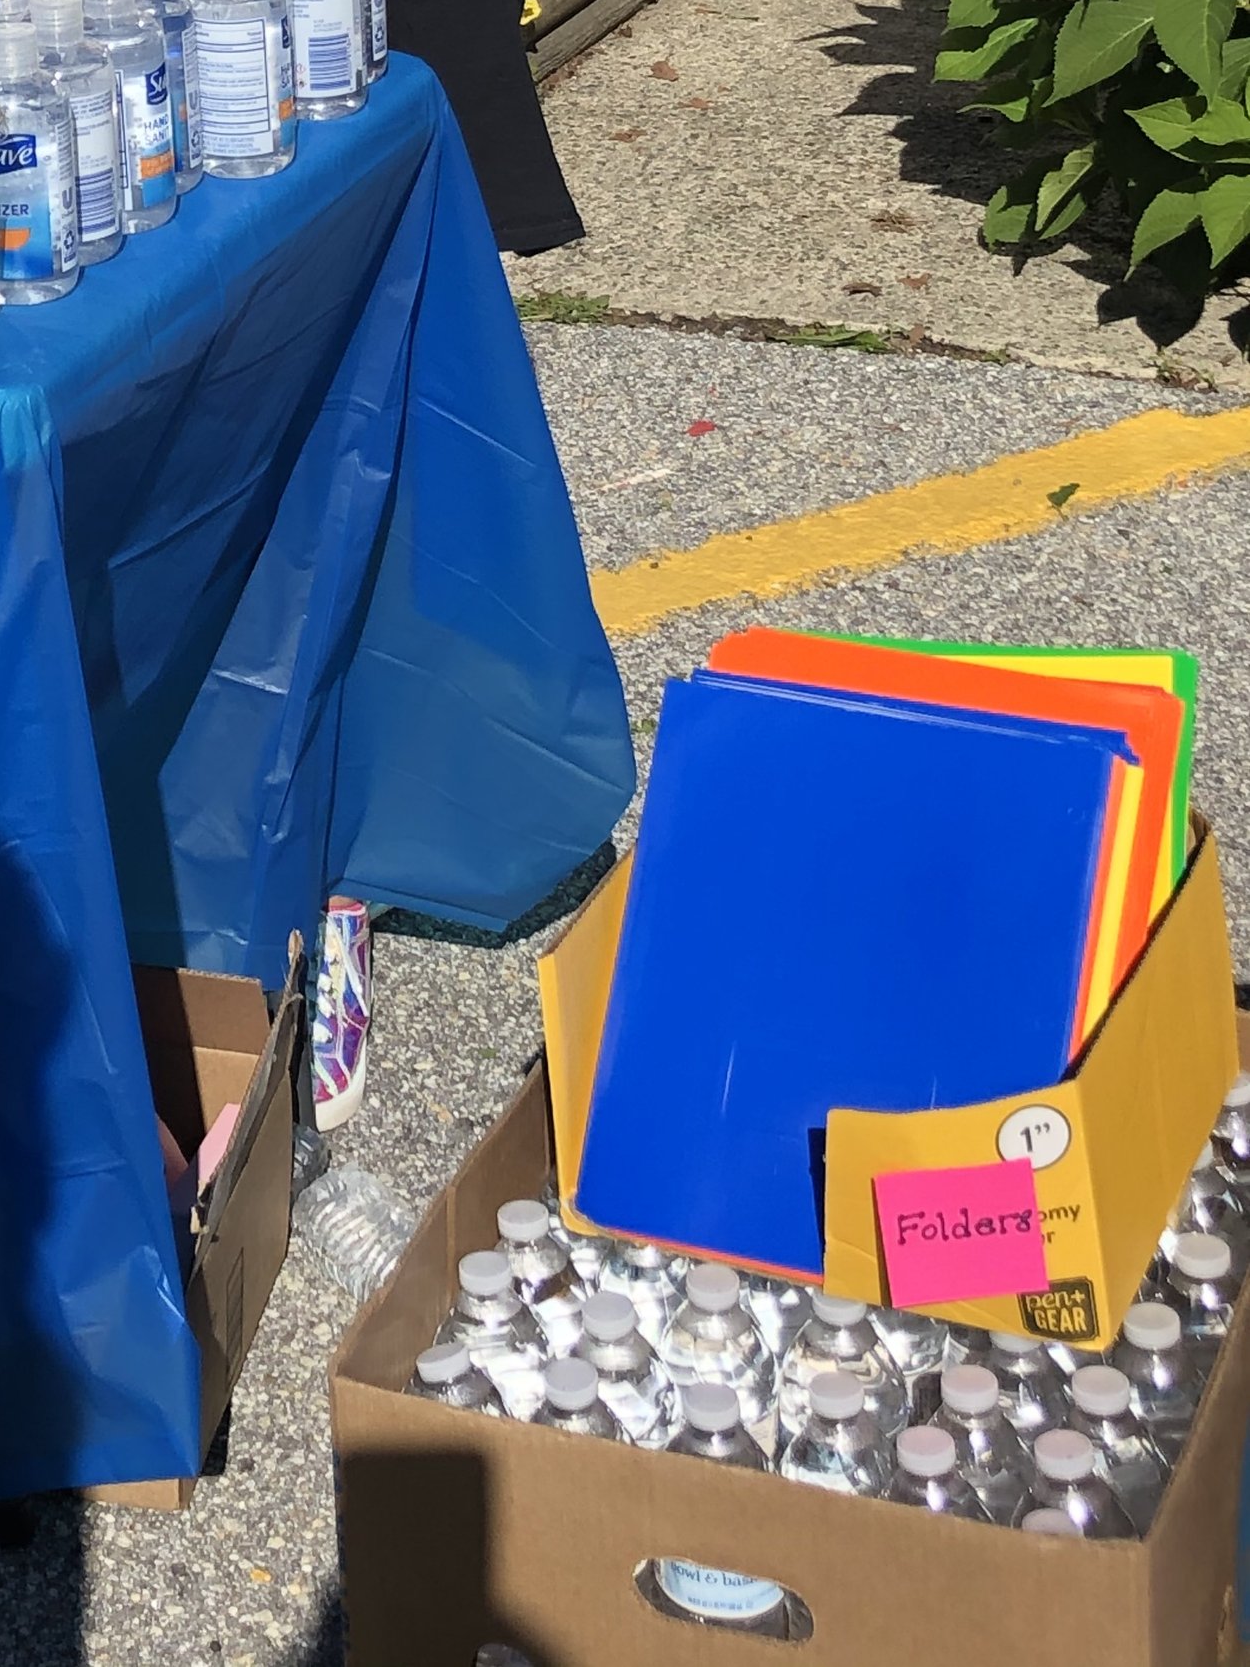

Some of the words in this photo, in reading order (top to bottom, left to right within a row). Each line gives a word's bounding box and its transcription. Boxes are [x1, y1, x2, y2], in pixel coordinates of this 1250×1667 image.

[897, 1208, 1033, 1246] Folders
[1036, 1204, 1081, 1223] omy
[1034, 1306, 1088, 1333] GEAR
